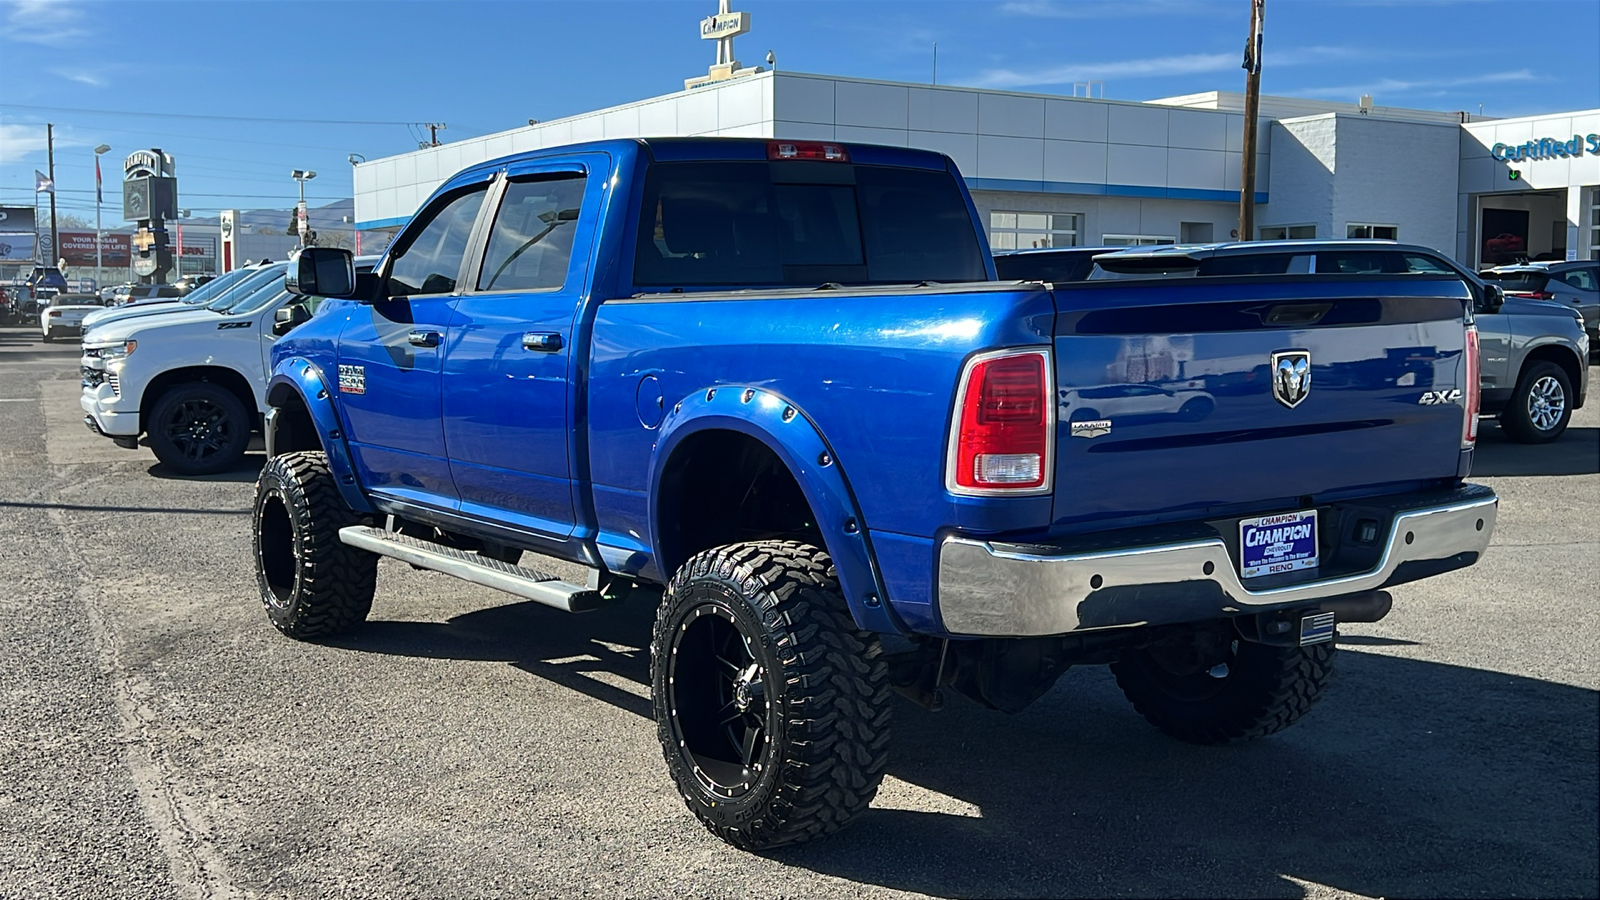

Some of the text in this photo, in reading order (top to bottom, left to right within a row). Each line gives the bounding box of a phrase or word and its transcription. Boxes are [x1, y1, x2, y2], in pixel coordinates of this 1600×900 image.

[1491, 134, 1579, 162] Certified
[1261, 514, 1298, 526] CHAMPION
[1246, 523, 1312, 547] CHAMPION
[1266, 544, 1292, 554] CHEVROLET
[1269, 563, 1293, 573] RENO
